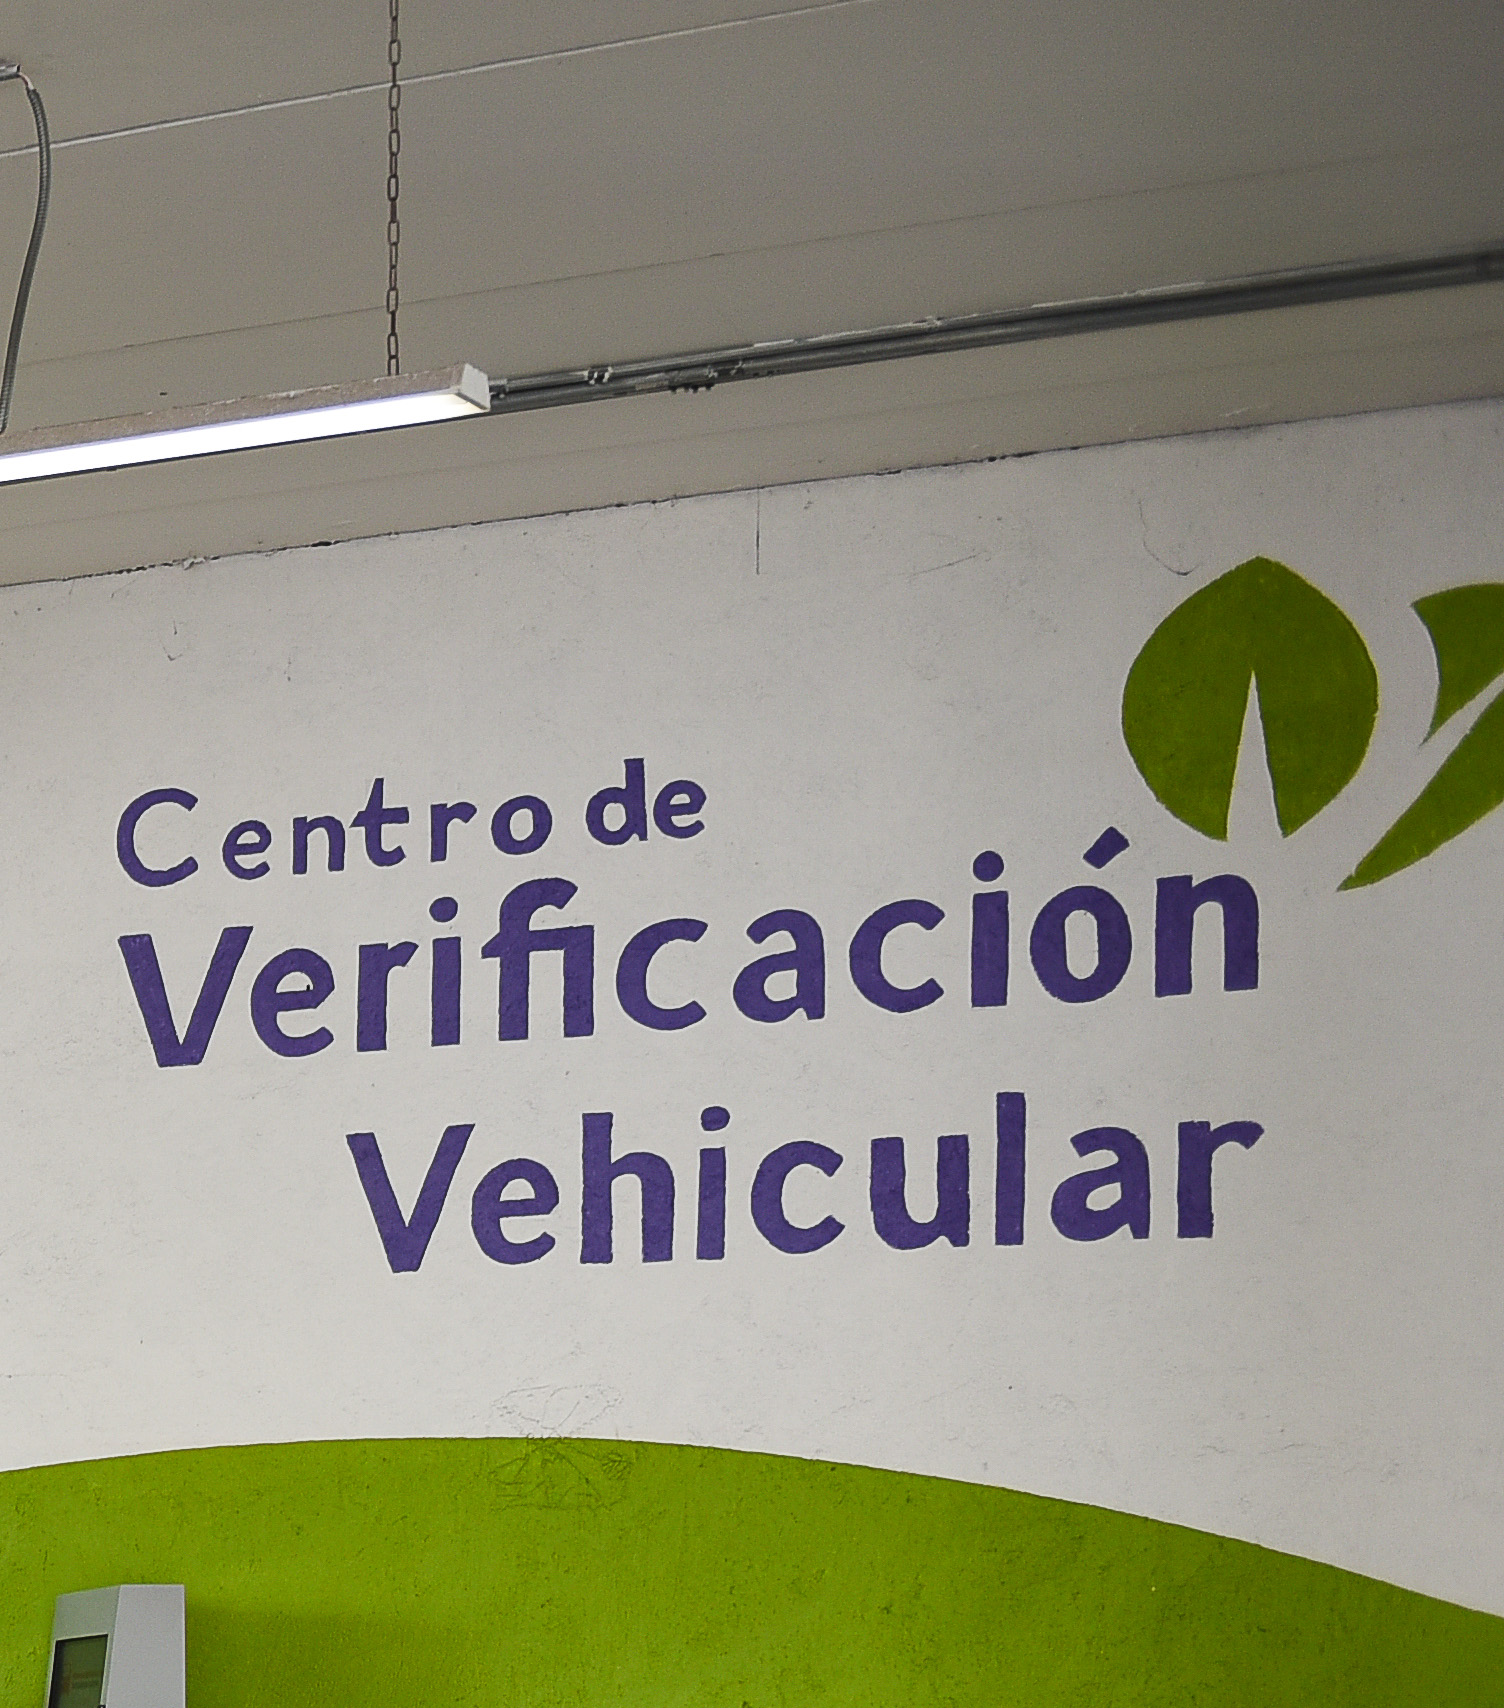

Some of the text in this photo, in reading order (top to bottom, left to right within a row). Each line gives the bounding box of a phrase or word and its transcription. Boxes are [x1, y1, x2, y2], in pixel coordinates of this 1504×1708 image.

[116, 757, 707, 887] Centro de
[118, 827, 1259, 1068] Verificación
[346, 1091, 1265, 1273] Vehicular
